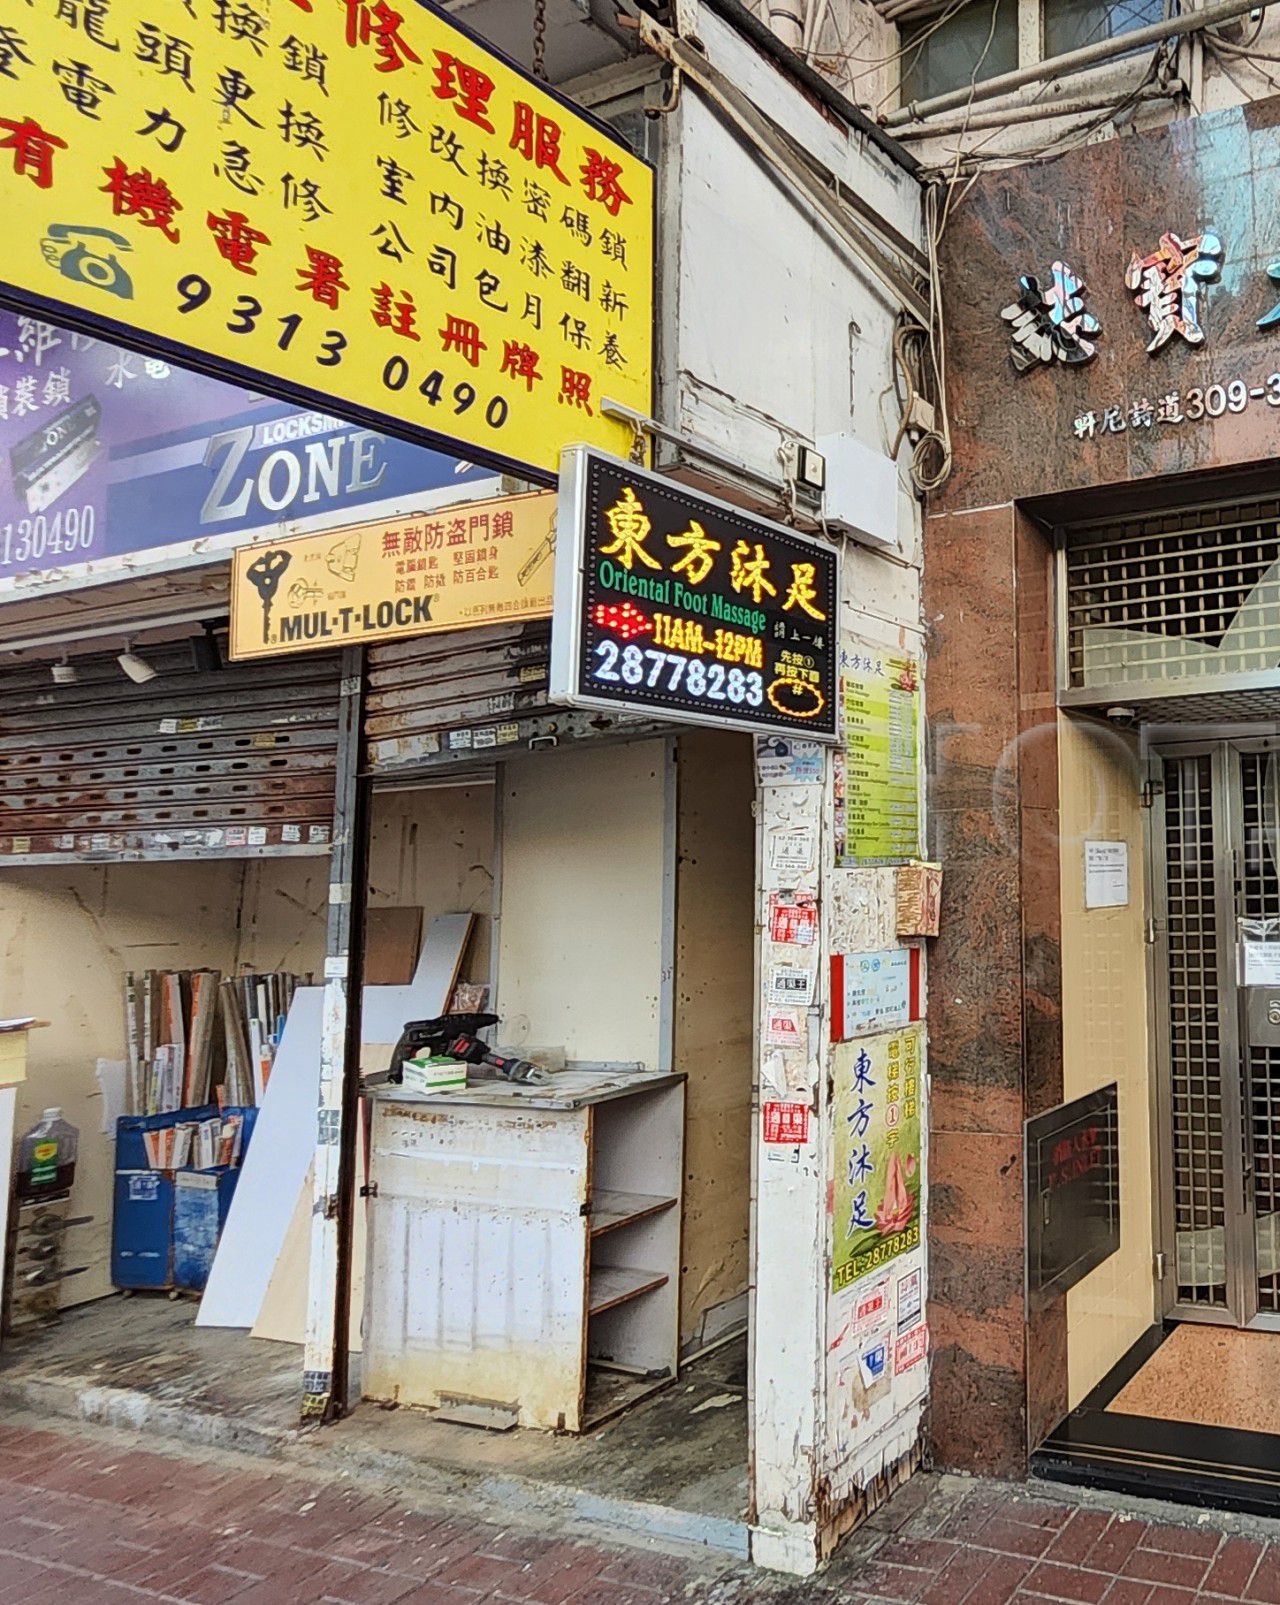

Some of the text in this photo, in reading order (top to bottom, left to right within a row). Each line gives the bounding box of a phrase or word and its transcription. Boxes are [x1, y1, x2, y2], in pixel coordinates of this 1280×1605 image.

[183, 0, 329, 97] 換鎖
[286, 0, 633, 216] 修理服務
[175, 273, 508, 429] 9313 0490
[200, 425, 388, 525] ZONE
[600, 486, 826, 620] 東方沐足
[600, 560, 767, 634] Oriental Foot Massage
[594, 640, 763, 707] 28778283
[846, 1047, 877, 1239] 東方沐足
